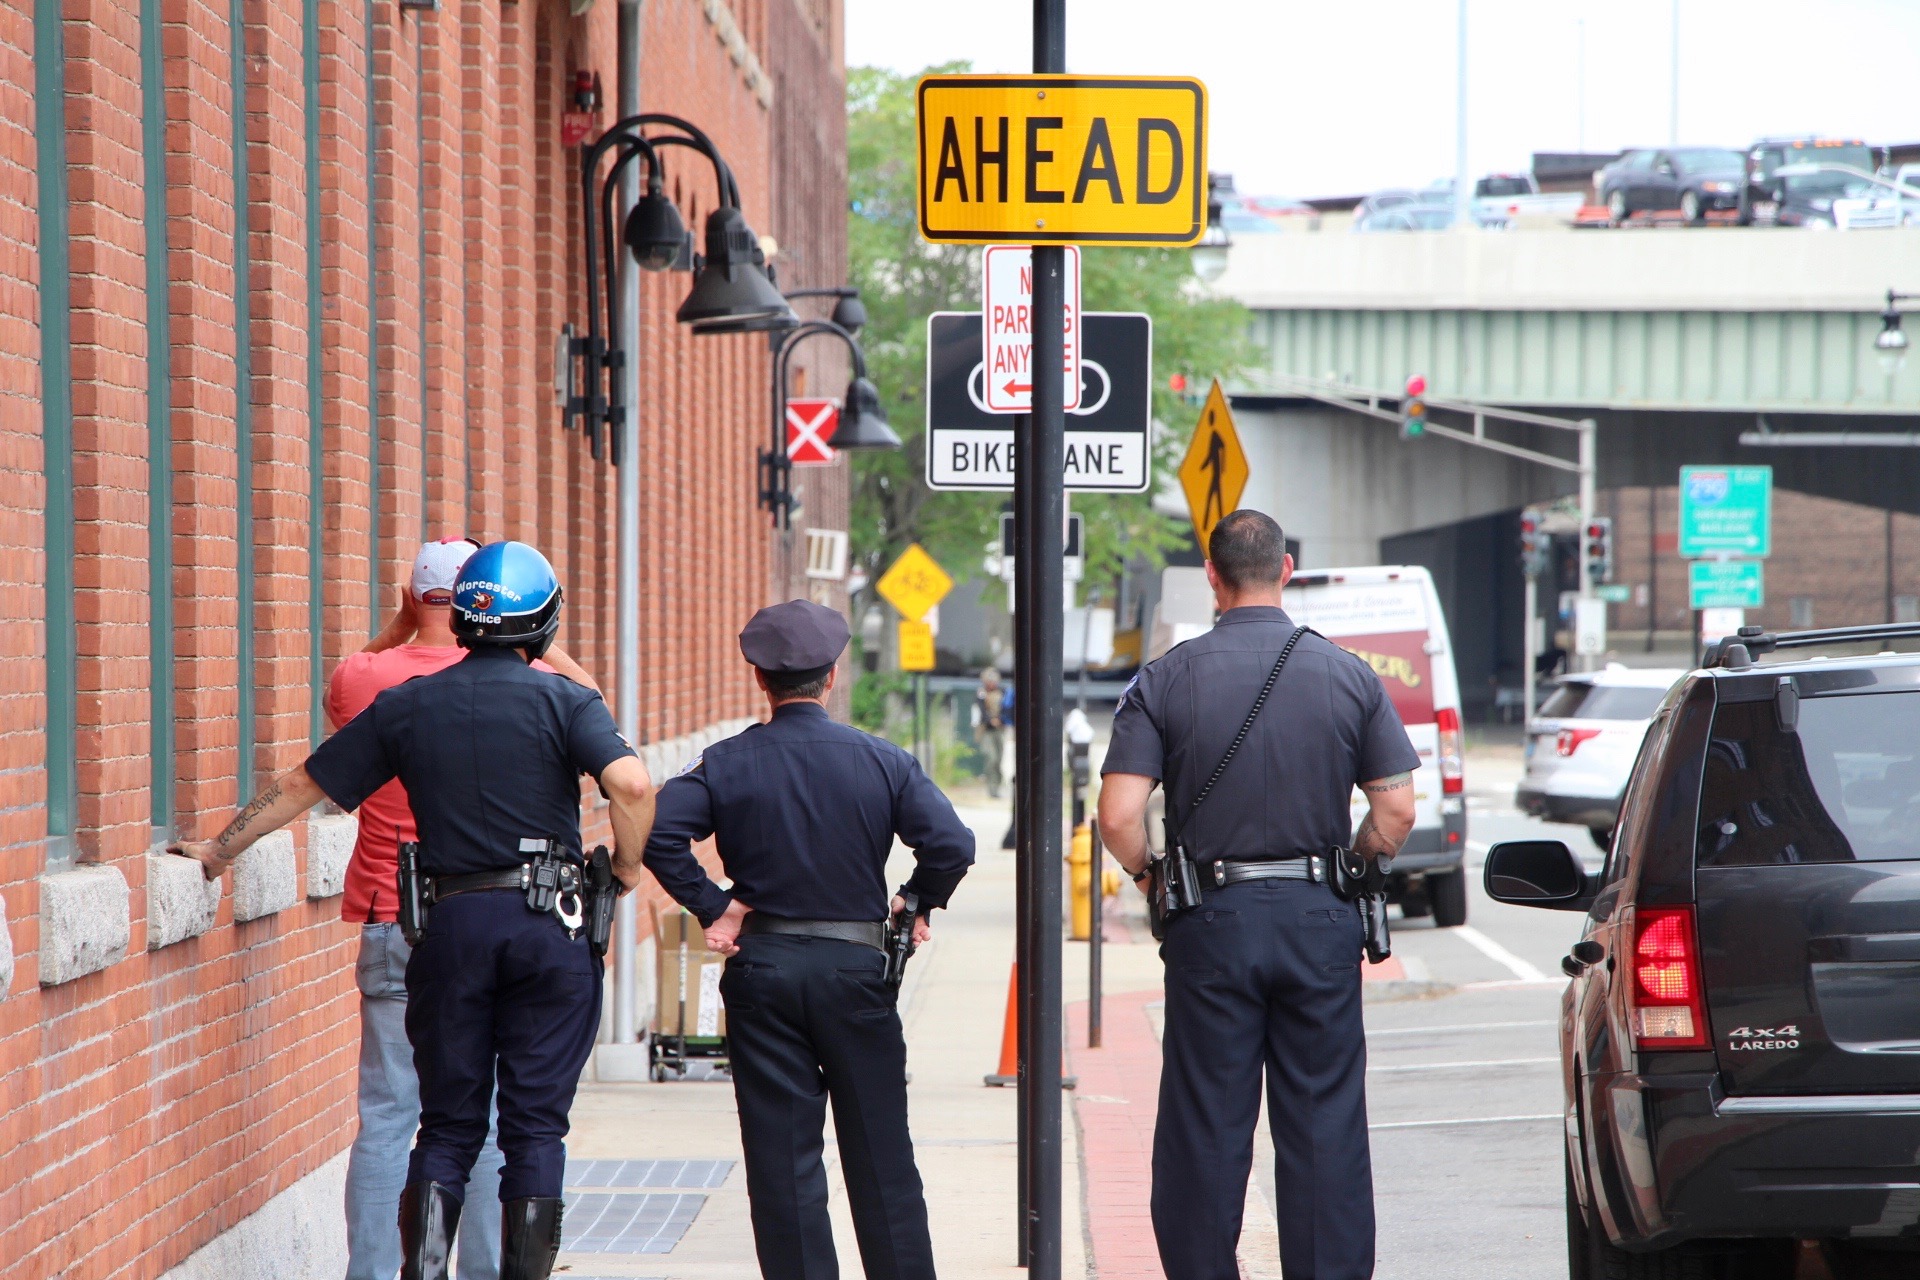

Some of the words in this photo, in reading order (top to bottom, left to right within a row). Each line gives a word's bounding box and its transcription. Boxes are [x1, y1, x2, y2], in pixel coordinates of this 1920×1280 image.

[933, 116, 1184, 204] AHEAD
[994, 304, 1072, 334] PARG
[994, 344, 1072, 373] ANYE
[1063, 444, 1123, 474] ANE
[456, 580, 522, 602] Worcester
[464, 609, 502, 624] Police
[1728, 1025, 1800, 1038] 4x4
[1730, 1039, 1799, 1051] LAREDO
